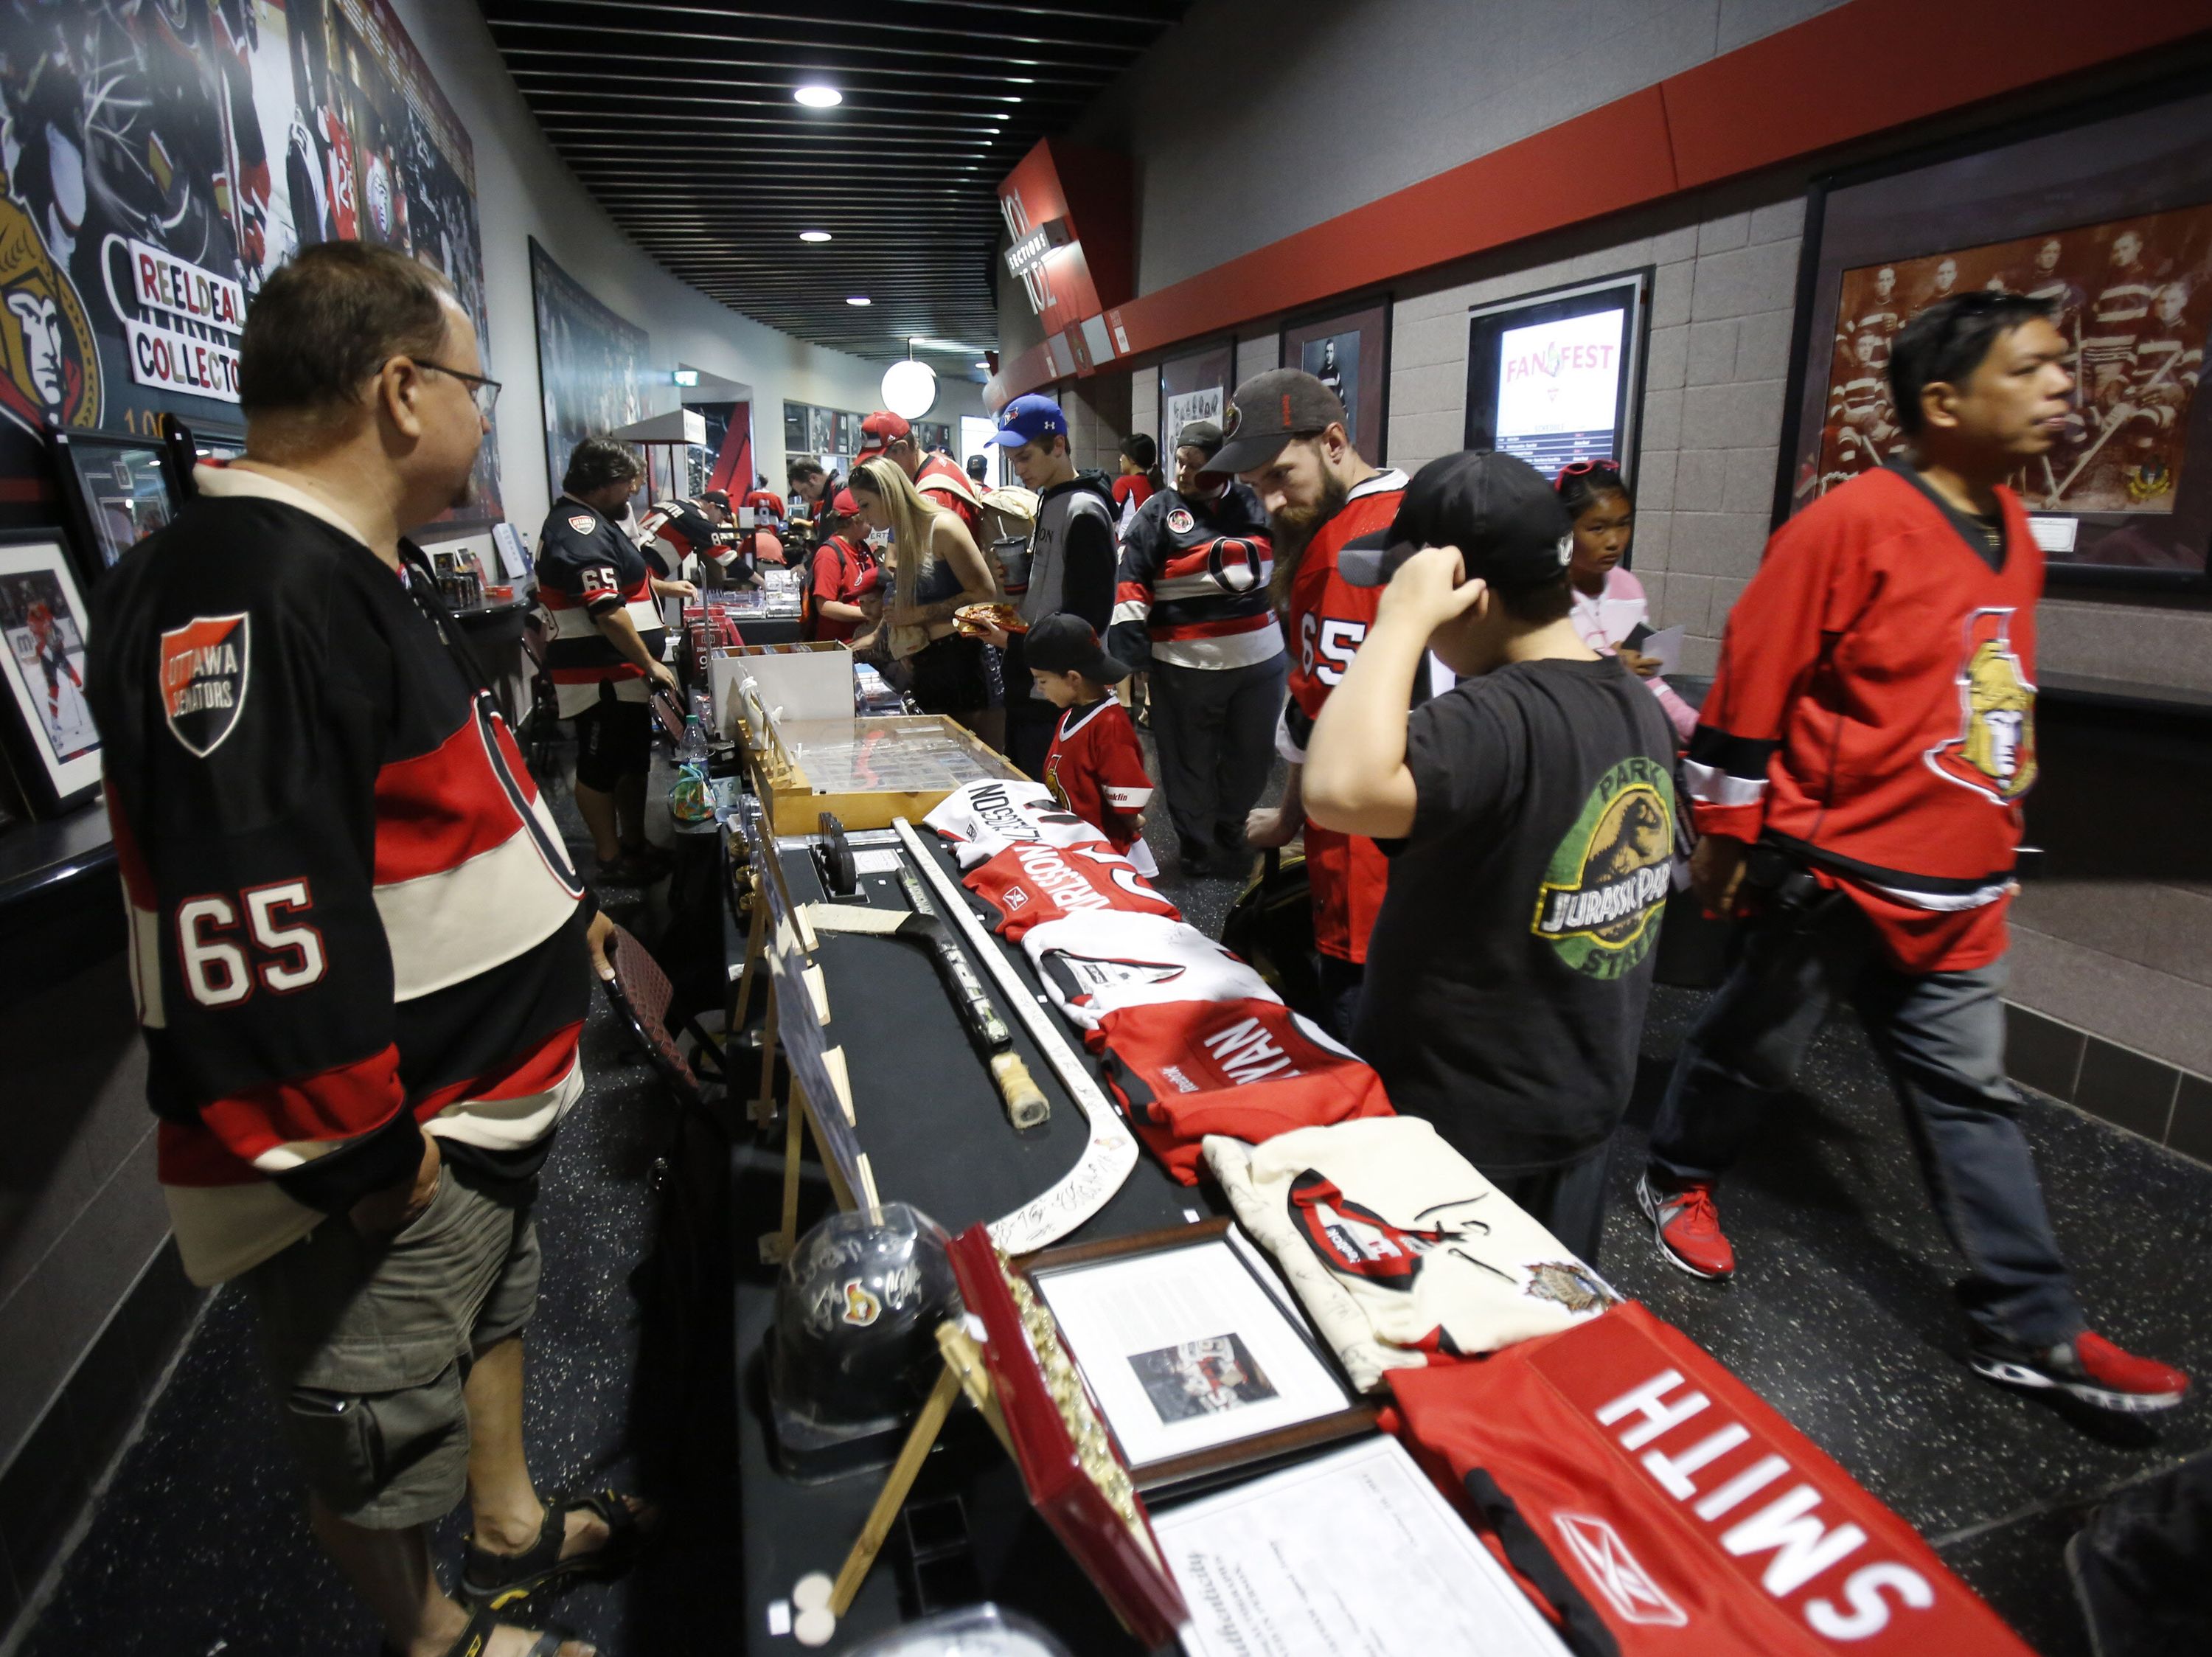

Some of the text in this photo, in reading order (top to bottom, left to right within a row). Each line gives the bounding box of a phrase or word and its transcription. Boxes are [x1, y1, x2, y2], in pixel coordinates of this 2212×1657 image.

[1001, 188, 1031, 245] 101
[1009, 232, 1046, 271] SECTIONS
[139, 253, 246, 329] REELDEAL
[1020, 260, 1057, 315] 102
[581, 567, 619, 591] 65
[168, 643, 238, 686] OTTAWA
[1301, 611, 1368, 687] 65
[173, 681, 233, 718] SENATORS
[1599, 758, 1660, 804] PARK
[1541, 860, 1672, 932] JURASSIC PAR
[175, 877, 328, 1009] 65
[1203, 1016, 1301, 1085] YAN
[1594, 1367, 1935, 1641] SMITH
